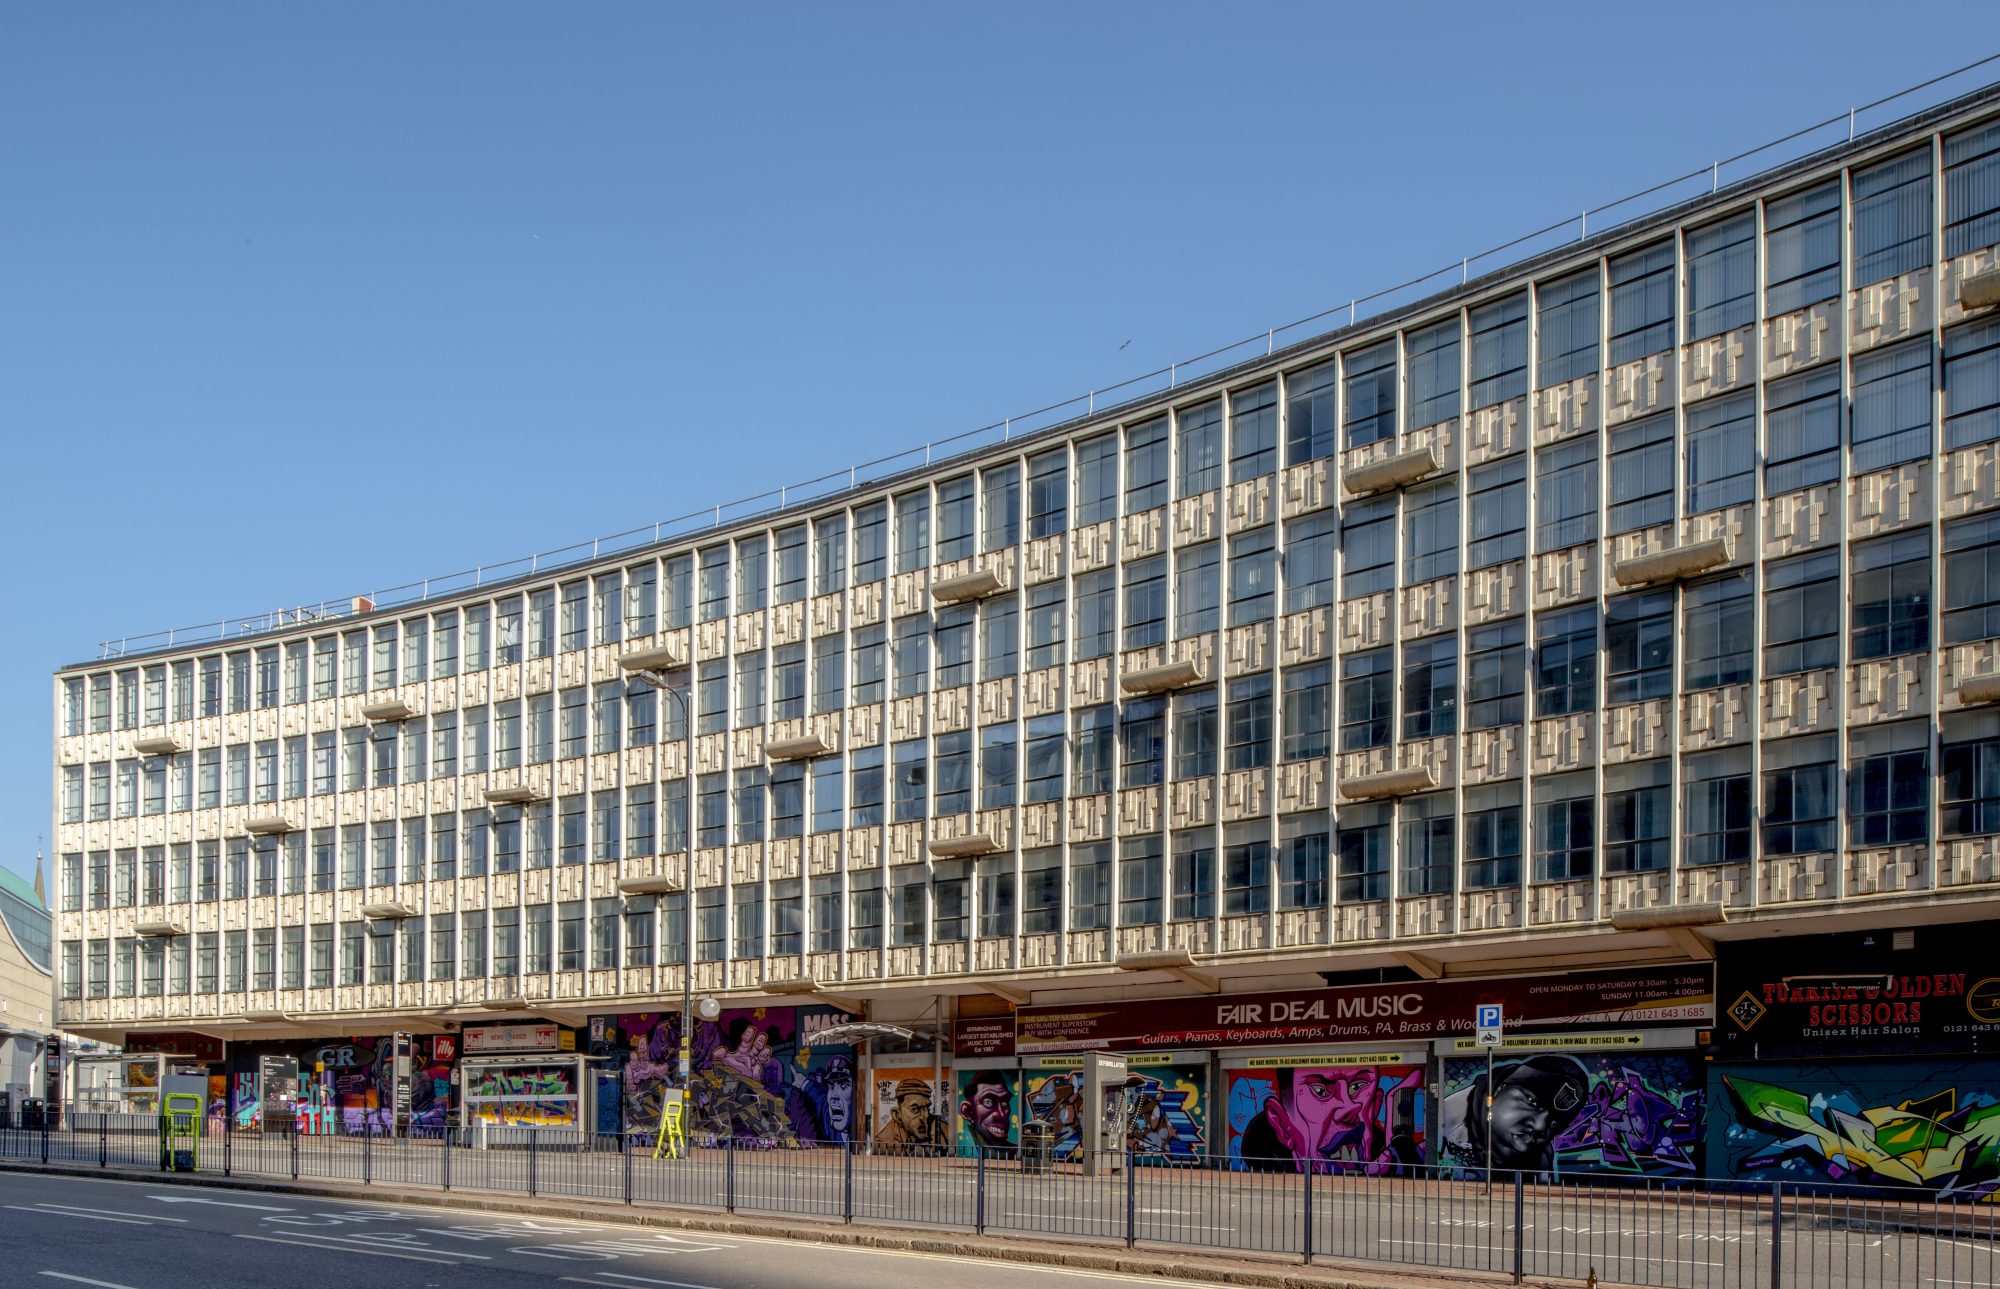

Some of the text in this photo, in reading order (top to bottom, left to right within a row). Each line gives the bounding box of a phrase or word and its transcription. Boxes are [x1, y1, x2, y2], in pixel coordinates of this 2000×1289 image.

[1529, 986, 1549, 994] OPEN
[1550, 984, 1584, 993] MONDAY
[1585, 983, 1596, 991] TO
[1597, 981, 1638, 990] SATURDAY
[1638, 978, 1667, 987] 9.30am
[1674, 977, 1705, 986] 5.30pm
[1601, 992, 1632, 1000] SUNDAY
[1635, 990, 1668, 998] 11.00am
[1674, 988, 1705, 997] 4.00pm
[1217, 993, 1423, 1025] FAIR DEAL MUSIC
[1483, 1008, 1498, 1026] P
[1636, 1007, 1705, 1020] 0121 643 1685
[1809, 1002, 1921, 1026] SCISSORS
[804, 1014, 849, 1031] MASS
[1024, 1020, 1098, 1030] INSTRUMENT SUPERSTORE
[1053, 1027, 1090, 1035] CONFIDENCE
[1142, 1015, 1523, 1045] Guitars, Pianos, Keyboards, Amps, Drums, PA, Brass & Wooind
[1802, 1025, 1920, 1037] Unisex Hair Salon
[1943, 1025, 1968, 1033] 0121
[1971, 1024, 1991, 1032] 643
[465, 1034, 483, 1047] Mail
[536, 1031, 555, 1045] Mail
[980, 1031, 1014, 1039] ESTABLISHED
[1574, 1037, 1587, 1045] WALK
[317, 1048, 356, 1067] GR
[437, 1040, 455, 1058] illy
[261, 1209, 444, 1227] CAR
[347, 1220, 604, 1247] PARK
[505, 1234, 740, 1262] ONLY
